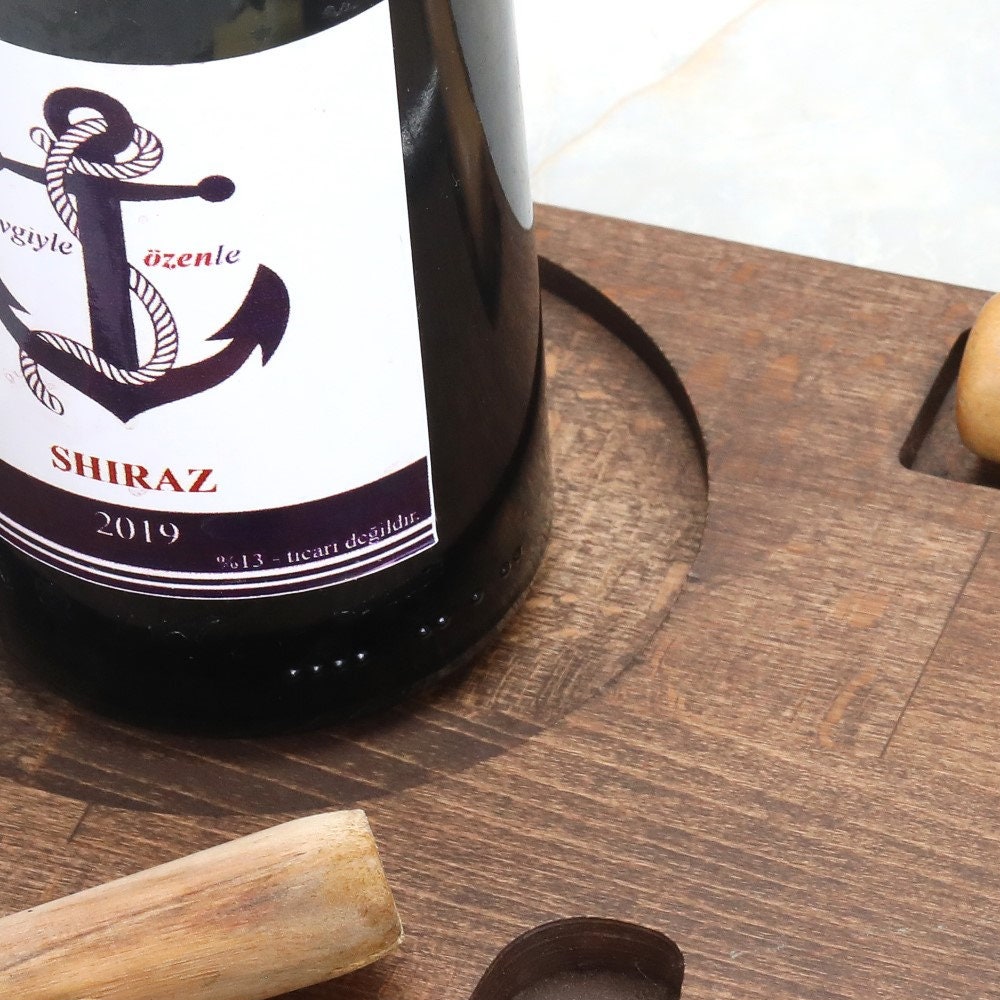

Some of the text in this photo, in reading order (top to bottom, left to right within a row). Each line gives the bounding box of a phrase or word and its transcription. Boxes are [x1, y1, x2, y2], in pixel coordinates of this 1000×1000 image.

[143, 245, 241, 270] özenle
[50, 444, 218, 494] SHIRAZ
[95, 510, 181, 545] 2019
